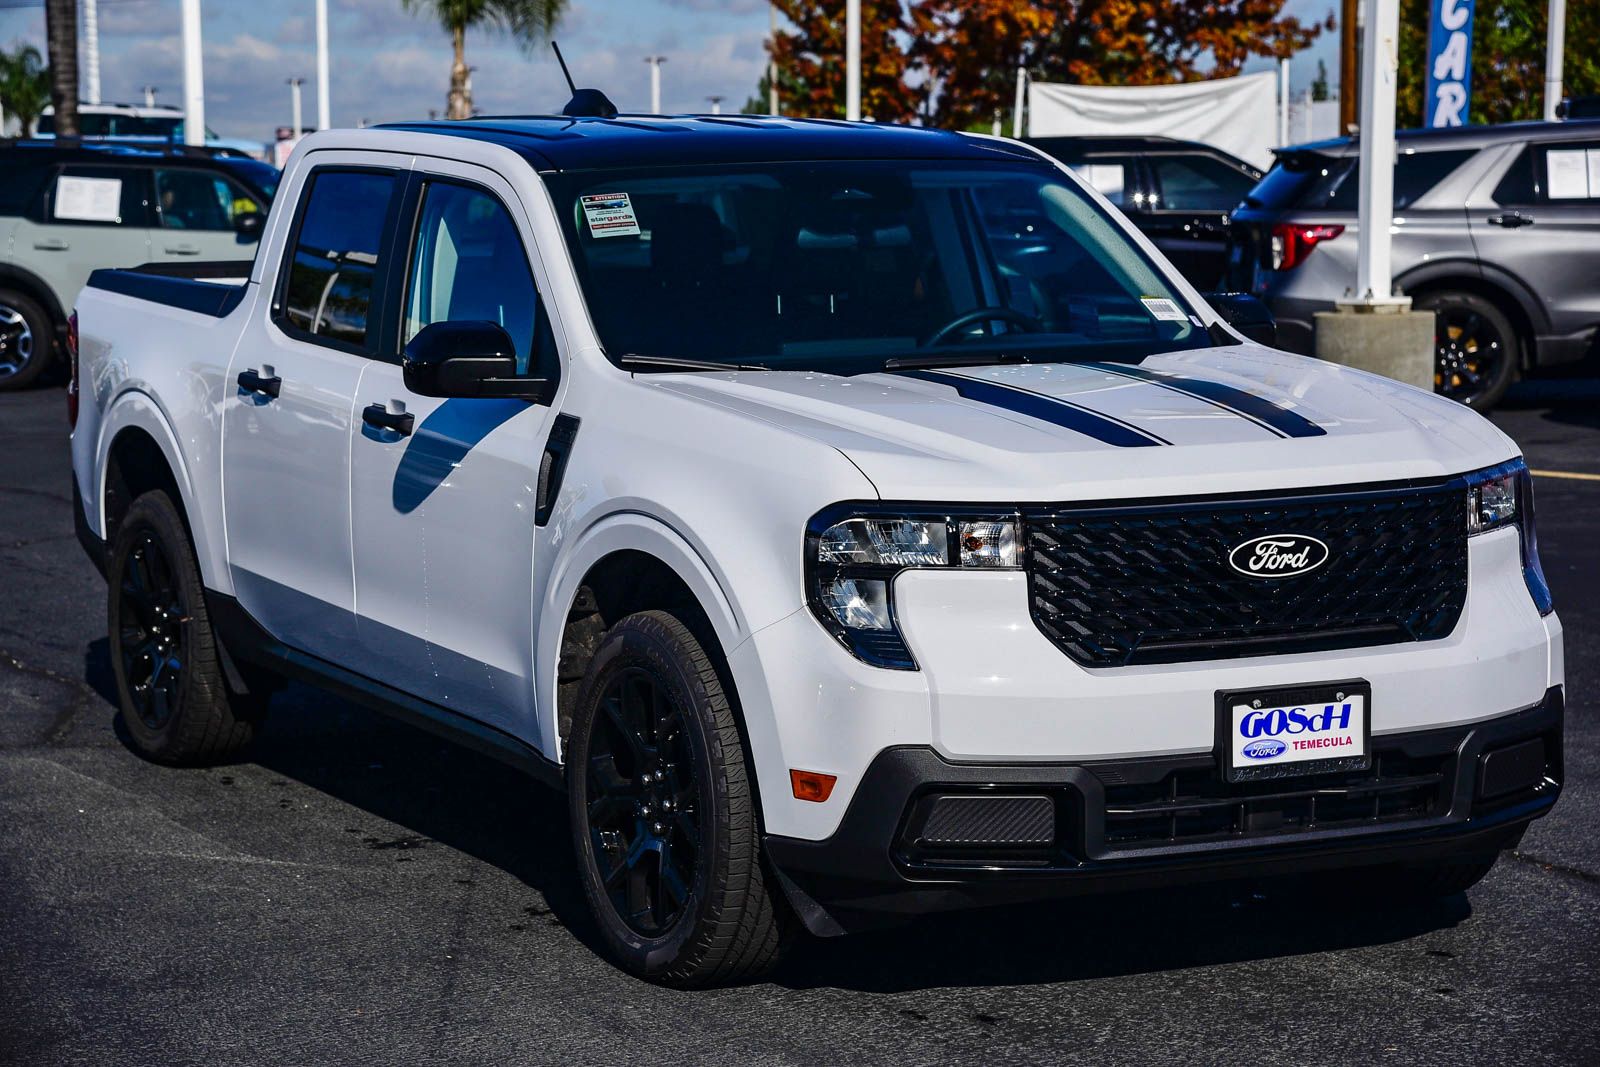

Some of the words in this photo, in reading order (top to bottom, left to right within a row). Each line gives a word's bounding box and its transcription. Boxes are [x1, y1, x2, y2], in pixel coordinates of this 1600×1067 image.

[1248, 540, 1310, 571] Ford
[1250, 741, 1279, 757] Ford
[1292, 736, 1353, 750] TEMECULA
